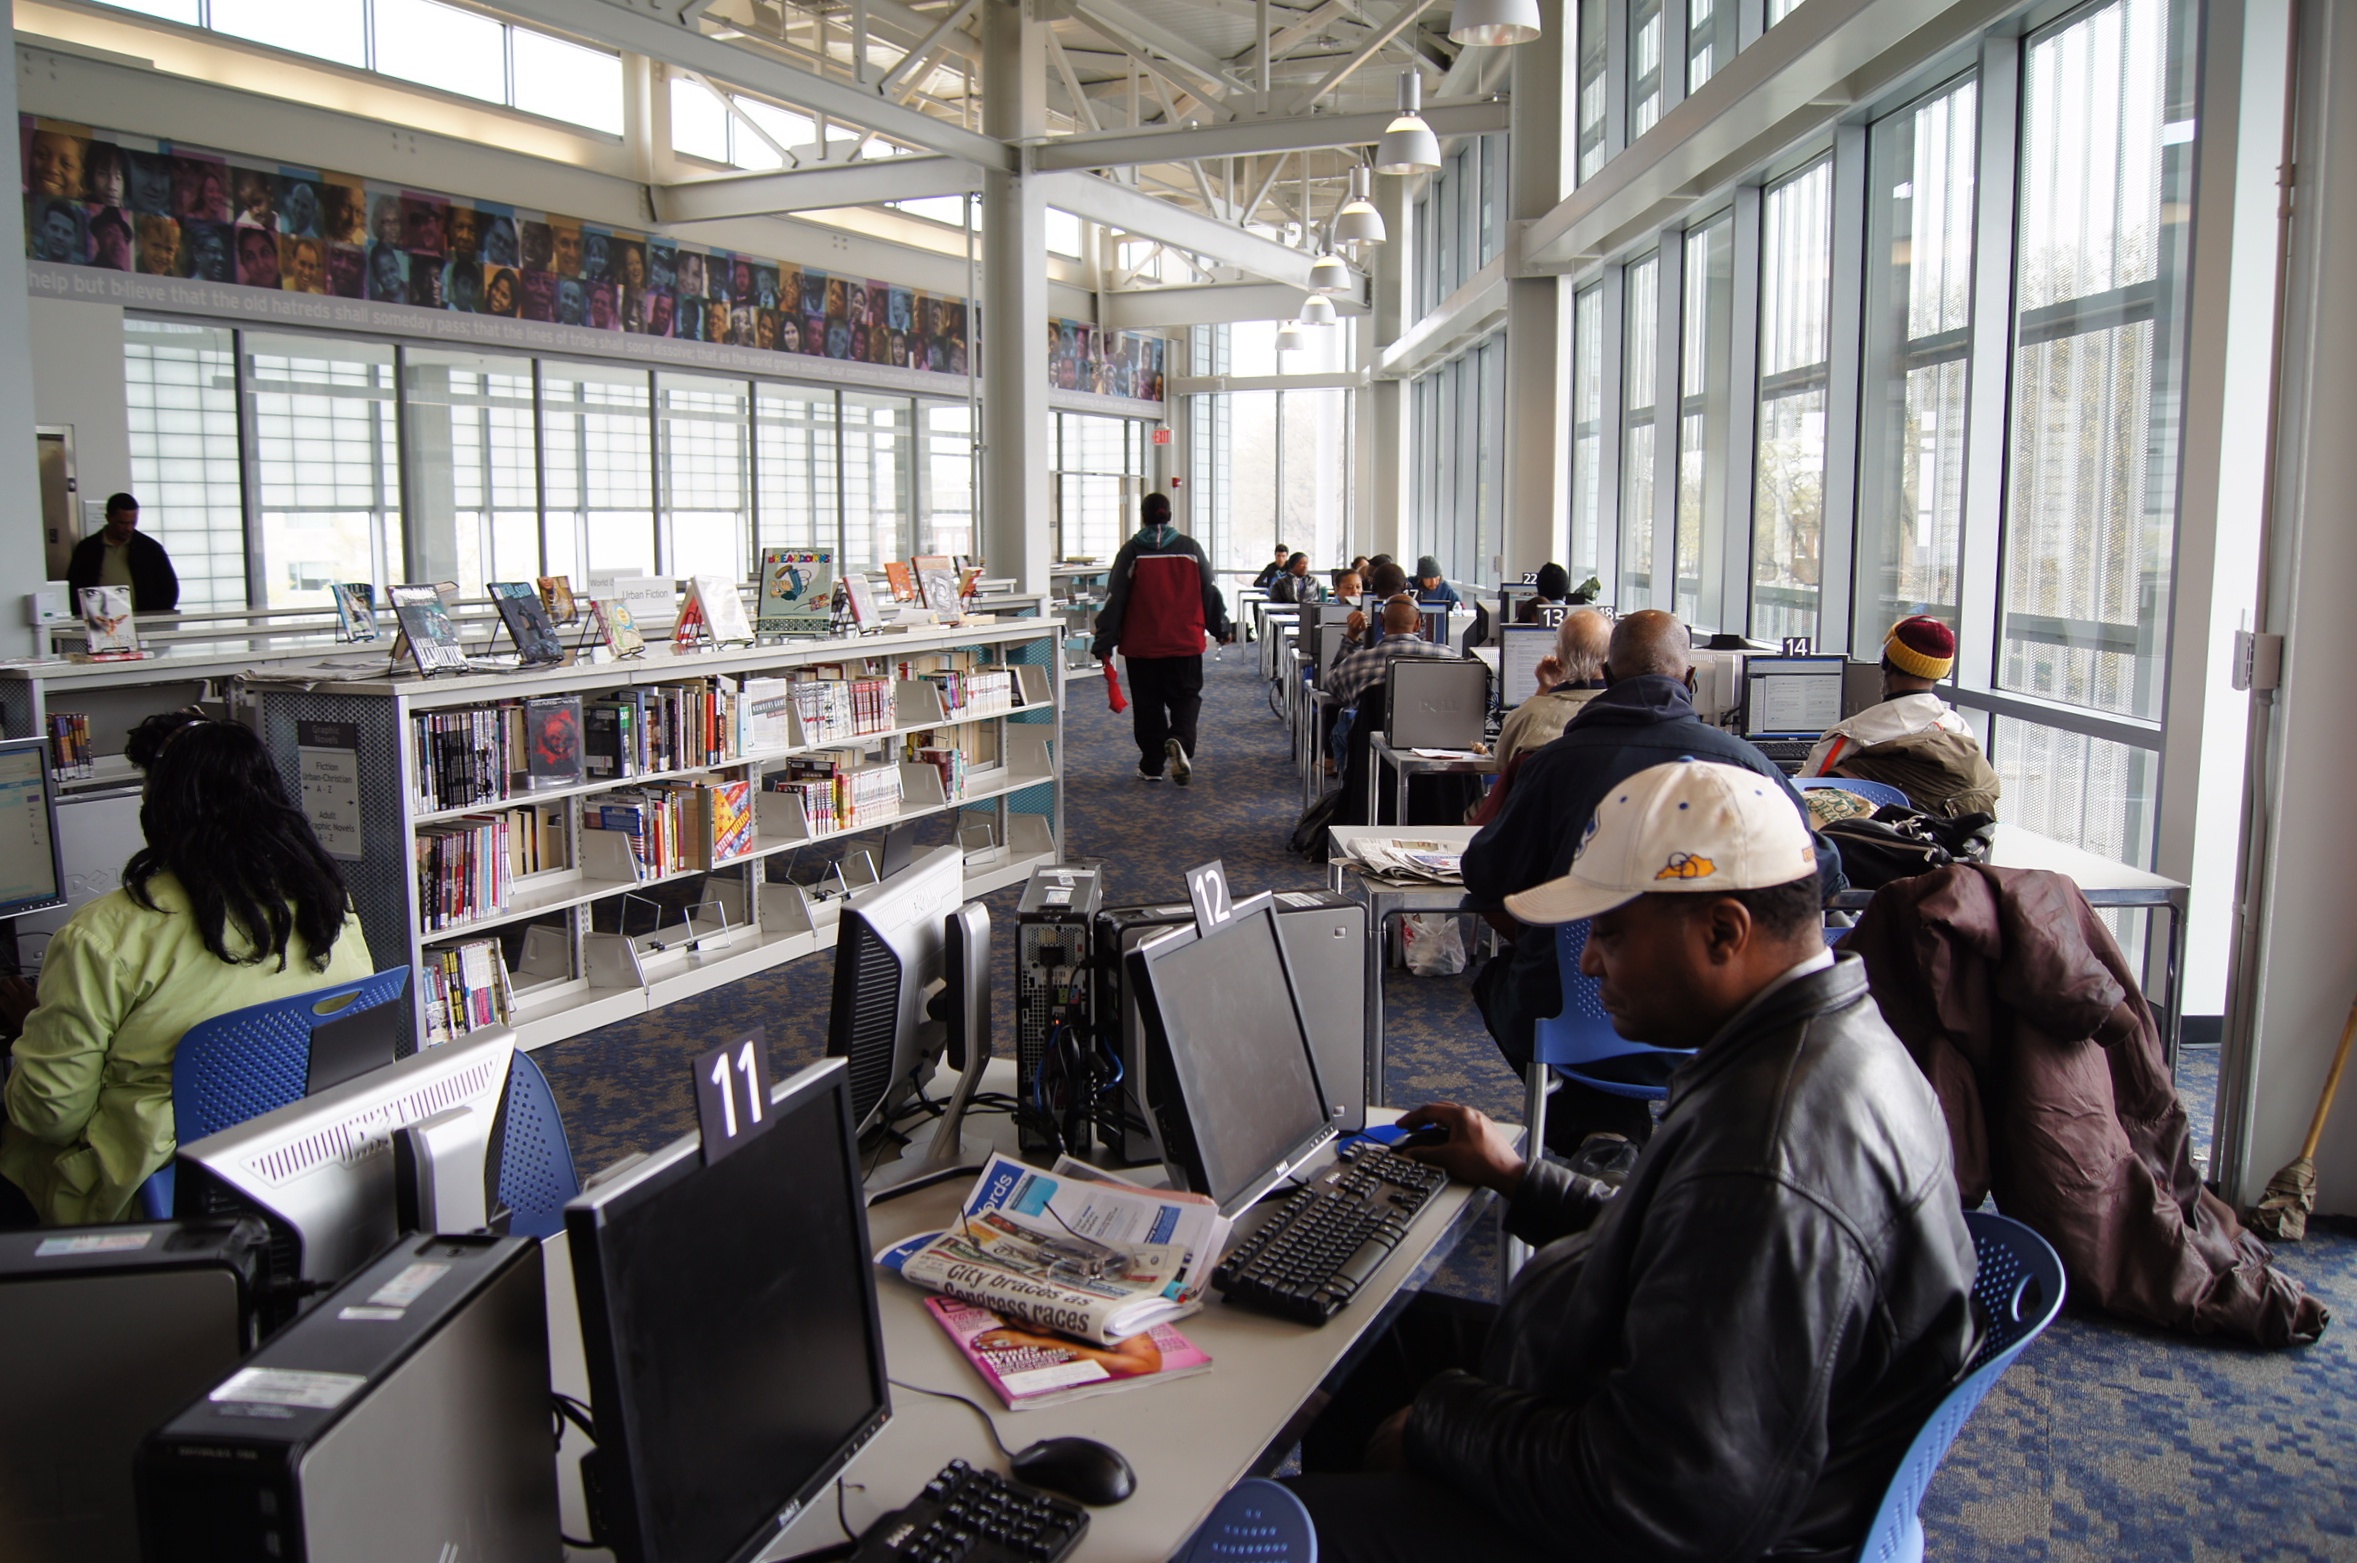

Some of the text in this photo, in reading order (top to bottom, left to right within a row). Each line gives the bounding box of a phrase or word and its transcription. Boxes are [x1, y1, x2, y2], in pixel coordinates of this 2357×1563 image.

[28, 269, 69, 294] help
[75, 275, 105, 295] but
[111, 278, 165, 301] blieve
[170, 285, 207, 306] that
[211, 289, 239, 309] the
[244, 294, 268, 313] old
[272, 297, 330, 319] hatreds
[335, 305, 369, 324] shall
[373, 312, 434, 333] someday
[474, 320, 500, 338] that
[503, 324, 523, 340] the
[526, 323, 553, 343] lines
[556, 329, 568, 344] of
[569, 332, 596, 349] tribe
[599, 336, 625, 350] shall
[697, 349, 717, 363] that
[732, 352, 747, 366] the
[1155, 430, 1170, 443] EXIT
[590, 578, 608, 588] World
[1523, 573, 1537, 584] 22
[622, 589, 669, 600] Urban Fiction
[1403, 589, 1419, 600] 17
[1543, 608, 1564, 627] 13
[1599, 607, 1614, 620] 18
[1785, 637, 1808, 657] 14
[312, 725, 340, 736] Graphic
[314, 735, 339, 744] Novels
[316, 762, 339, 771] Fiction
[319, 811, 336, 820] Adult
[311, 822, 355, 833] raphic Novels
[1194, 869, 1231, 926] 12
[711, 1040, 762, 1137] 11
[978, 1172, 1014, 1214] ords
[946, 1263, 1094, 1307] City braces as
[944, 1282, 1028, 1321] Congress
[1032, 1300, 1090, 1334] races
